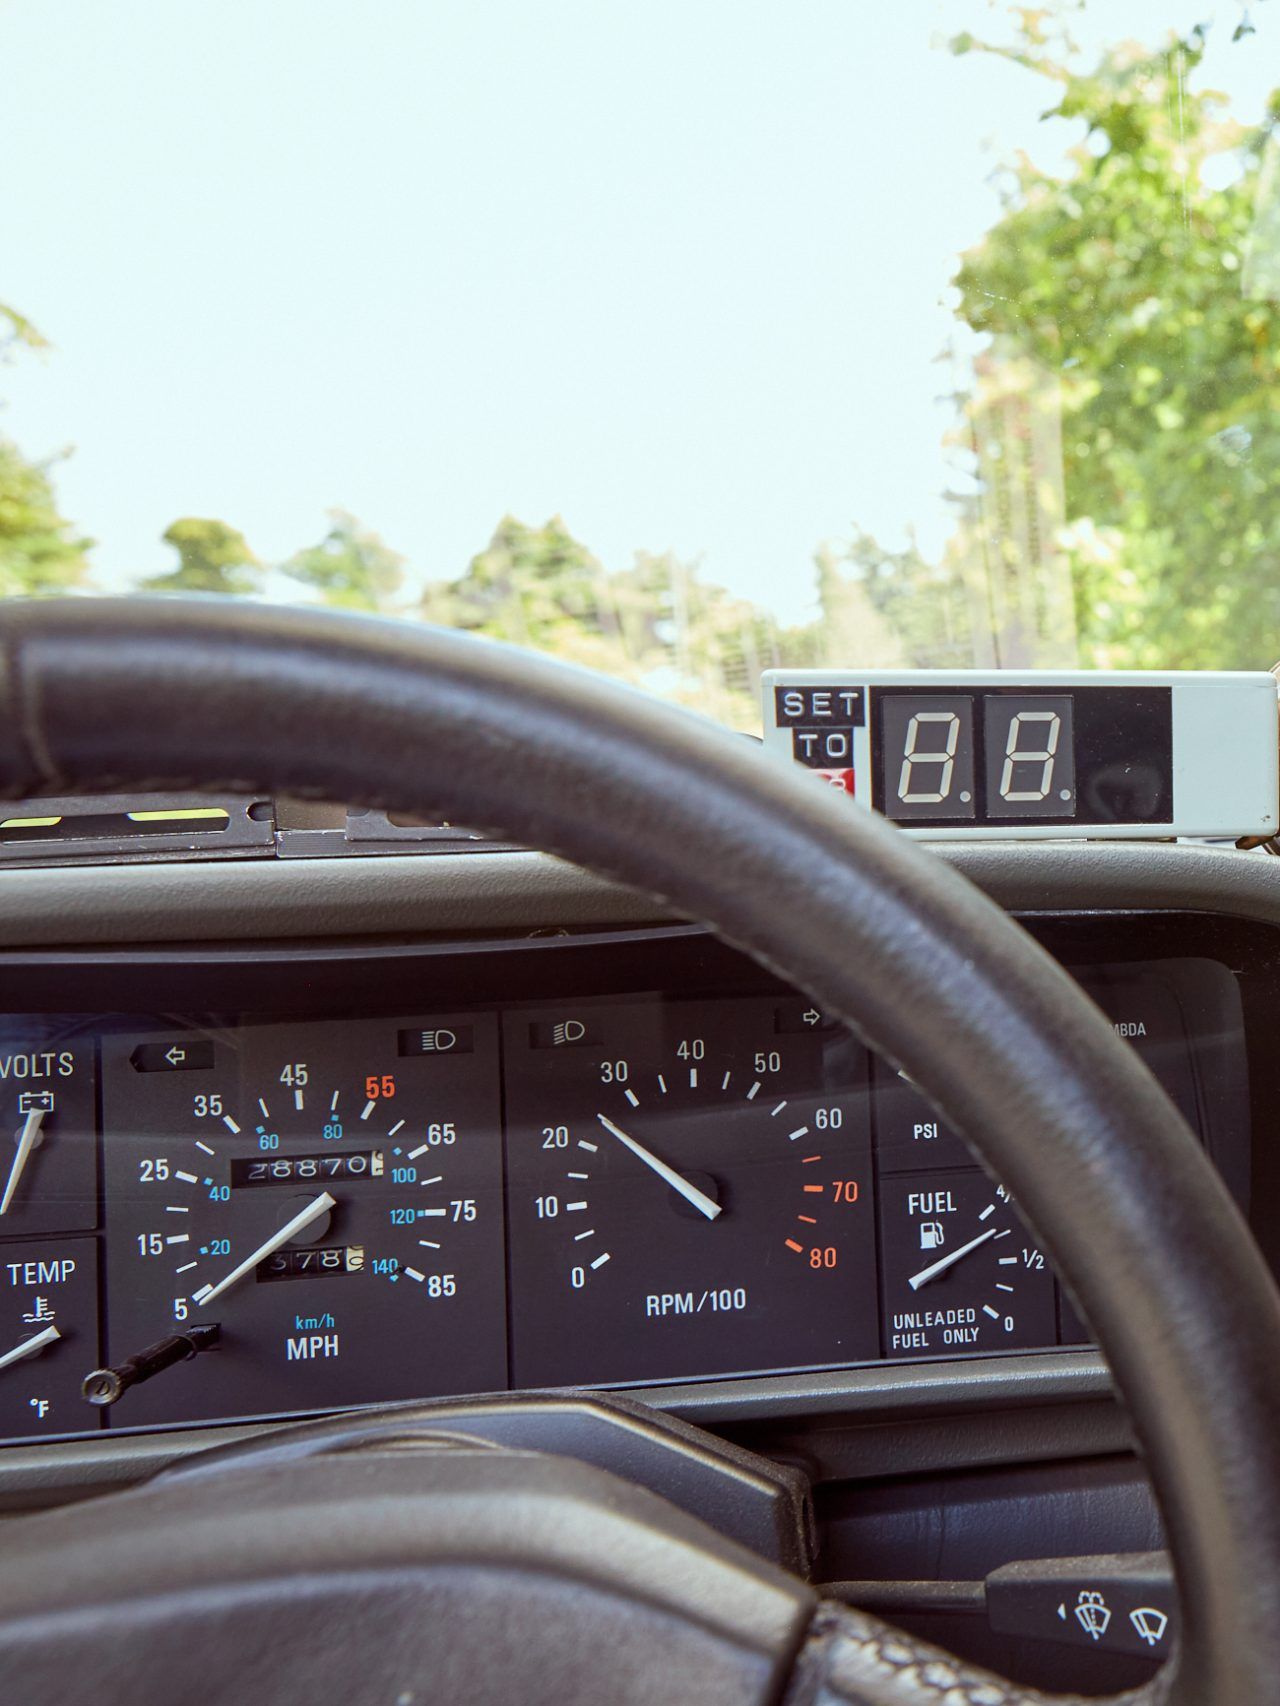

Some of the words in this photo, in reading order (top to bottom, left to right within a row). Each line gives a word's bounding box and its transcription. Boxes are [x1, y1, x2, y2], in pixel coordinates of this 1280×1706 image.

[784, 692, 859, 717] SET
[799, 733, 846, 757] TO
[676, 1039, 705, 1060] 40
[0, 1052, 74, 1078] VOLTS
[601, 1060, 628, 1083] 30
[755, 1052, 781, 1074] 50
[280, 1064, 308, 1087] 45
[365, 1076, 395, 1098] 55
[194, 1094, 223, 1117] 35
[815, 1108, 842, 1129] 60
[260, 1133, 279, 1150] 60
[323, 1123, 343, 1140] 80
[428, 1124, 456, 1145] 65
[542, 1126, 569, 1148] 20
[914, 1123, 938, 1139] PSI
[140, 1159, 169, 1182] 25
[391, 1167, 417, 1184] 100
[209, 1185, 230, 1202] 40
[832, 1181, 858, 1203] 70
[908, 1191, 957, 1215] FUEL
[389, 1208, 415, 1225] 120
[451, 1200, 477, 1222] 75
[535, 1196, 558, 1218] 10
[138, 1233, 163, 1255] 15
[210, 1239, 230, 1255] 20
[372, 1258, 399, 1275] 140
[809, 1247, 837, 1269] 80
[7, 1260, 76, 1286] TEMP
[571, 1266, 585, 1288] 0
[428, 1275, 456, 1297] 85
[174, 1299, 188, 1320] 5
[646, 1288, 747, 1316] RPM/100
[295, 1313, 336, 1330] km/h
[893, 1308, 976, 1330] UNLEADED
[1004, 1316, 1014, 1332] 0
[287, 1335, 339, 1360] MPH
[892, 1330, 929, 1350] FUEL
[943, 1326, 980, 1346] ONLY
